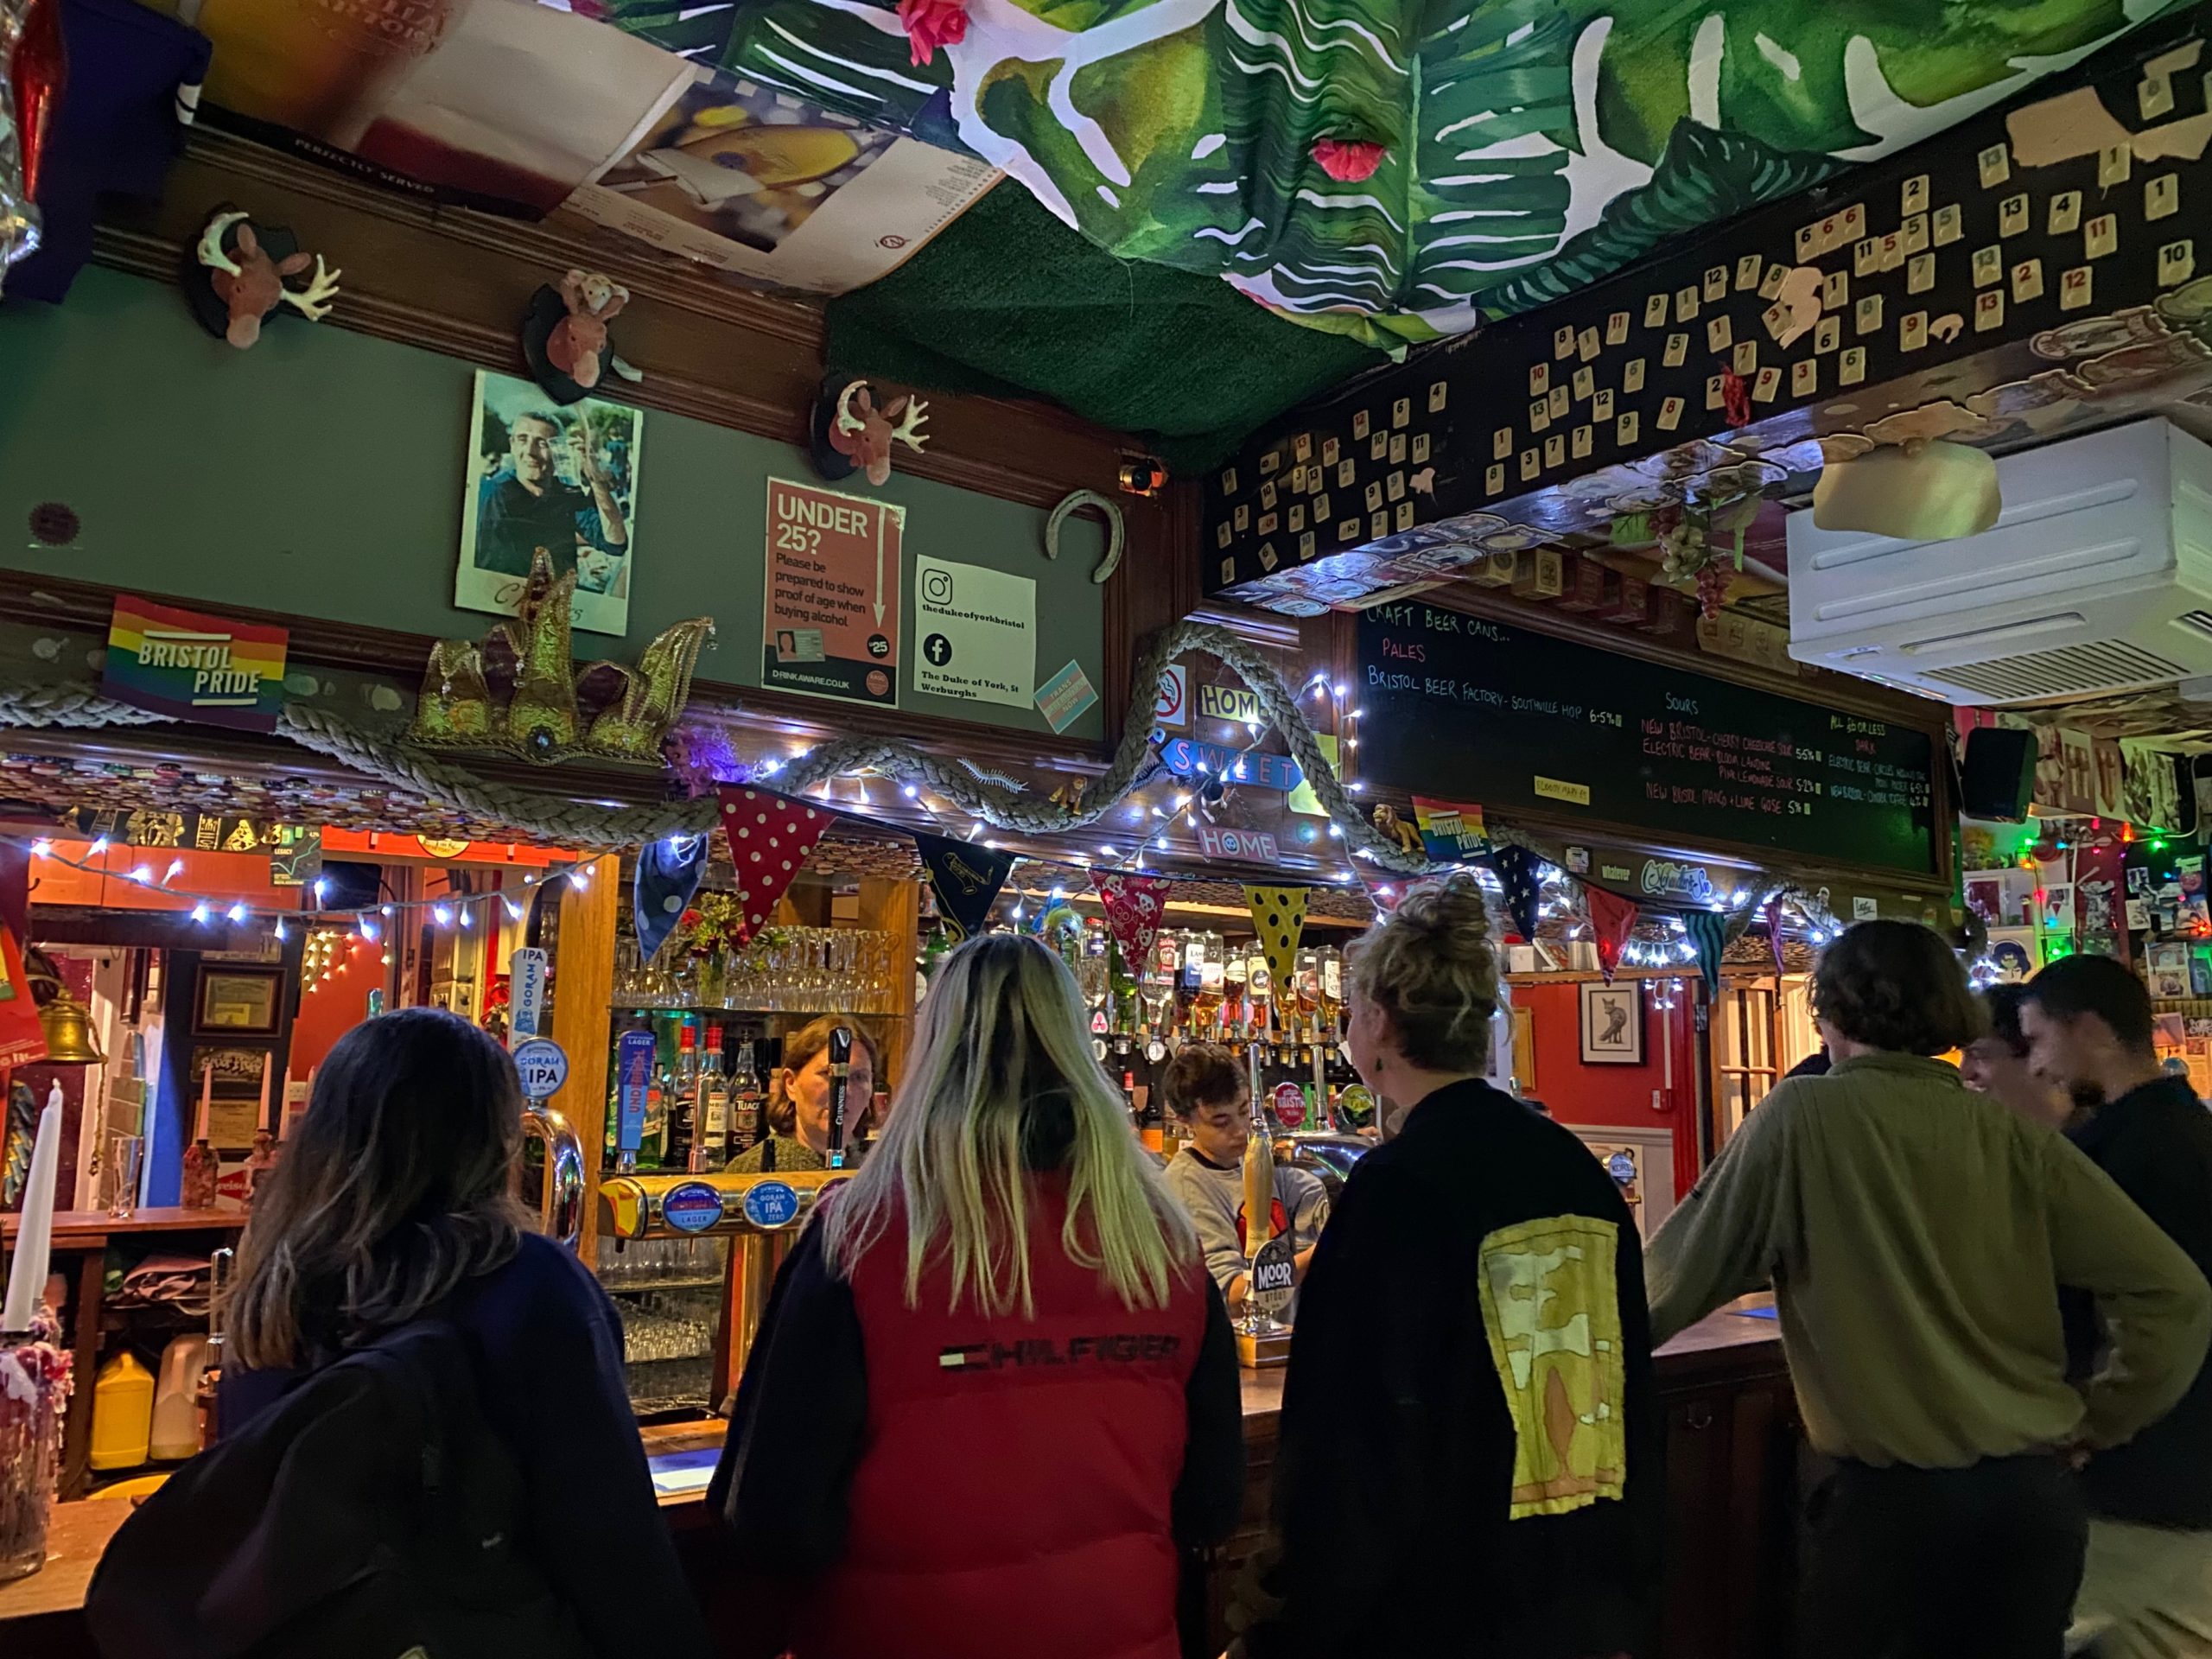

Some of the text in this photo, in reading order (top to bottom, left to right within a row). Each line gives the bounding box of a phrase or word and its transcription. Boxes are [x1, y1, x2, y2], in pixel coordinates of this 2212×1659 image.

[2110, 147, 2118, 164] 1
[295, 138, 435, 194] PERFECTLY SERVED
[1909, 181, 1921, 196] 2
[2155, 180, 2164, 197] 1
[2003, 199, 2022, 217] 13
[2056, 195, 2070, 213] 4
[1846, 209, 1857, 224] 6
[1940, 210, 1952, 226] 5
[1823, 219, 1833, 234] 6
[1908, 219, 1921, 235] 5
[2090, 219, 2107, 238] 11
[1802, 228, 1812, 243] 6
[1884, 235, 1896, 251] 5
[1858, 240, 1872, 257] 11
[2164, 245, 2186, 264] 10
[1744, 257, 1754, 272] 7
[1916, 257, 1927, 274] 7
[1707, 269, 1721, 284] 12
[1770, 268, 1782, 282] 8
[2018, 264, 2032, 282] 2
[2064, 270, 2086, 289] 12
[1830, 276, 1838, 290] 1
[1651, 297, 1660, 311] 9
[1683, 289, 1689, 304] 1
[1980, 295, 1999, 312] 13
[1611, 315, 1624, 329] 11
[1768, 308, 1779, 322] 3
[1714, 321, 1721, 334] 1
[1906, 316, 1917, 332] 9
[1559, 329, 1567, 343] 8
[1670, 335, 1681, 350] 5
[1738, 344, 1749, 360] 7
[1847, 351, 1856, 365] 6
[1532, 366, 1544, 380] 10
[1577, 370, 1586, 384] 4
[1761, 371, 1772, 385] 9
[1798, 364, 1808, 378] 3
[1433, 385, 1440, 397] 4
[1713, 378, 1721, 392] 2
[1596, 391, 1609, 407] 12
[1666, 399, 1676, 414] 8
[1396, 400, 1403, 414] 6
[1532, 402, 1544, 416] 13
[1356, 414, 1365, 427] 12
[1621, 415, 1630, 429] 9
[1297, 437, 1307, 449] 13
[1374, 432, 1383, 446] 10
[1415, 436, 1424, 450] 11
[1498, 432, 1504, 444] 1
[1576, 429, 1586, 442] 7
[1548, 438, 1558, 452] 7
[1525, 452, 1533, 465] 3
[1296, 467, 1302, 480] 3
[1309, 467, 1318, 480] 13
[1490, 467, 1497, 480] 8
[1262, 485, 1272, 497] 10
[1368, 486, 1376, 499] 9
[778, 493, 868, 538] UNDER
[1237, 507, 1243, 518] 3
[1400, 505, 1408, 518] 3
[777, 523, 822, 555] 25?
[776, 553, 827, 573] Please be
[775, 571, 865, 597] prepared to show
[774, 588, 867, 614] proof of age when
[774, 603, 849, 627] buying alcohol
[922, 603, 1026, 630] thedukeofyorkbristol
[1426, 608, 1460, 634] BEER
[137, 641, 233, 670] BRISTOL
[1382, 638, 1426, 663] PALES
[193, 670, 262, 694] PRIDE
[921, 671, 940, 682] The
[943, 674, 969, 685] Duke
[971, 678, 982, 687] of
[984, 679, 1008, 693] York,
[921, 683, 977, 698] Werburghs
[1368, 664, 1421, 690] BRISTOL
[1426, 677, 1459, 701] BEER
[1512, 695, 1558, 714] SOUTHVILLE
[1561, 705, 1583, 719] HOP
[1665, 692, 1700, 716] SOURS
[1641, 718, 1663, 735] NEW
[1643, 738, 1685, 759] ELECTRIC
[1645, 782, 1668, 800] NEW
[1430, 818, 1467, 837] BRISTOL
[1201, 830, 1277, 861] HOME
[1455, 833, 1485, 850] PRIDE
[523, 949, 544, 962] IPA
[524, 963, 536, 1007] GORAM
[528, 1069, 558, 1084] IPA
[835, 1084, 845, 1126] GUINNESS
[765, 1201, 784, 1215] IPA
[682, 1215, 708, 1224] LAGER
[1257, 1262, 1292, 1291] MOOR
[989, 1334, 1181, 1370] HILFIGER
